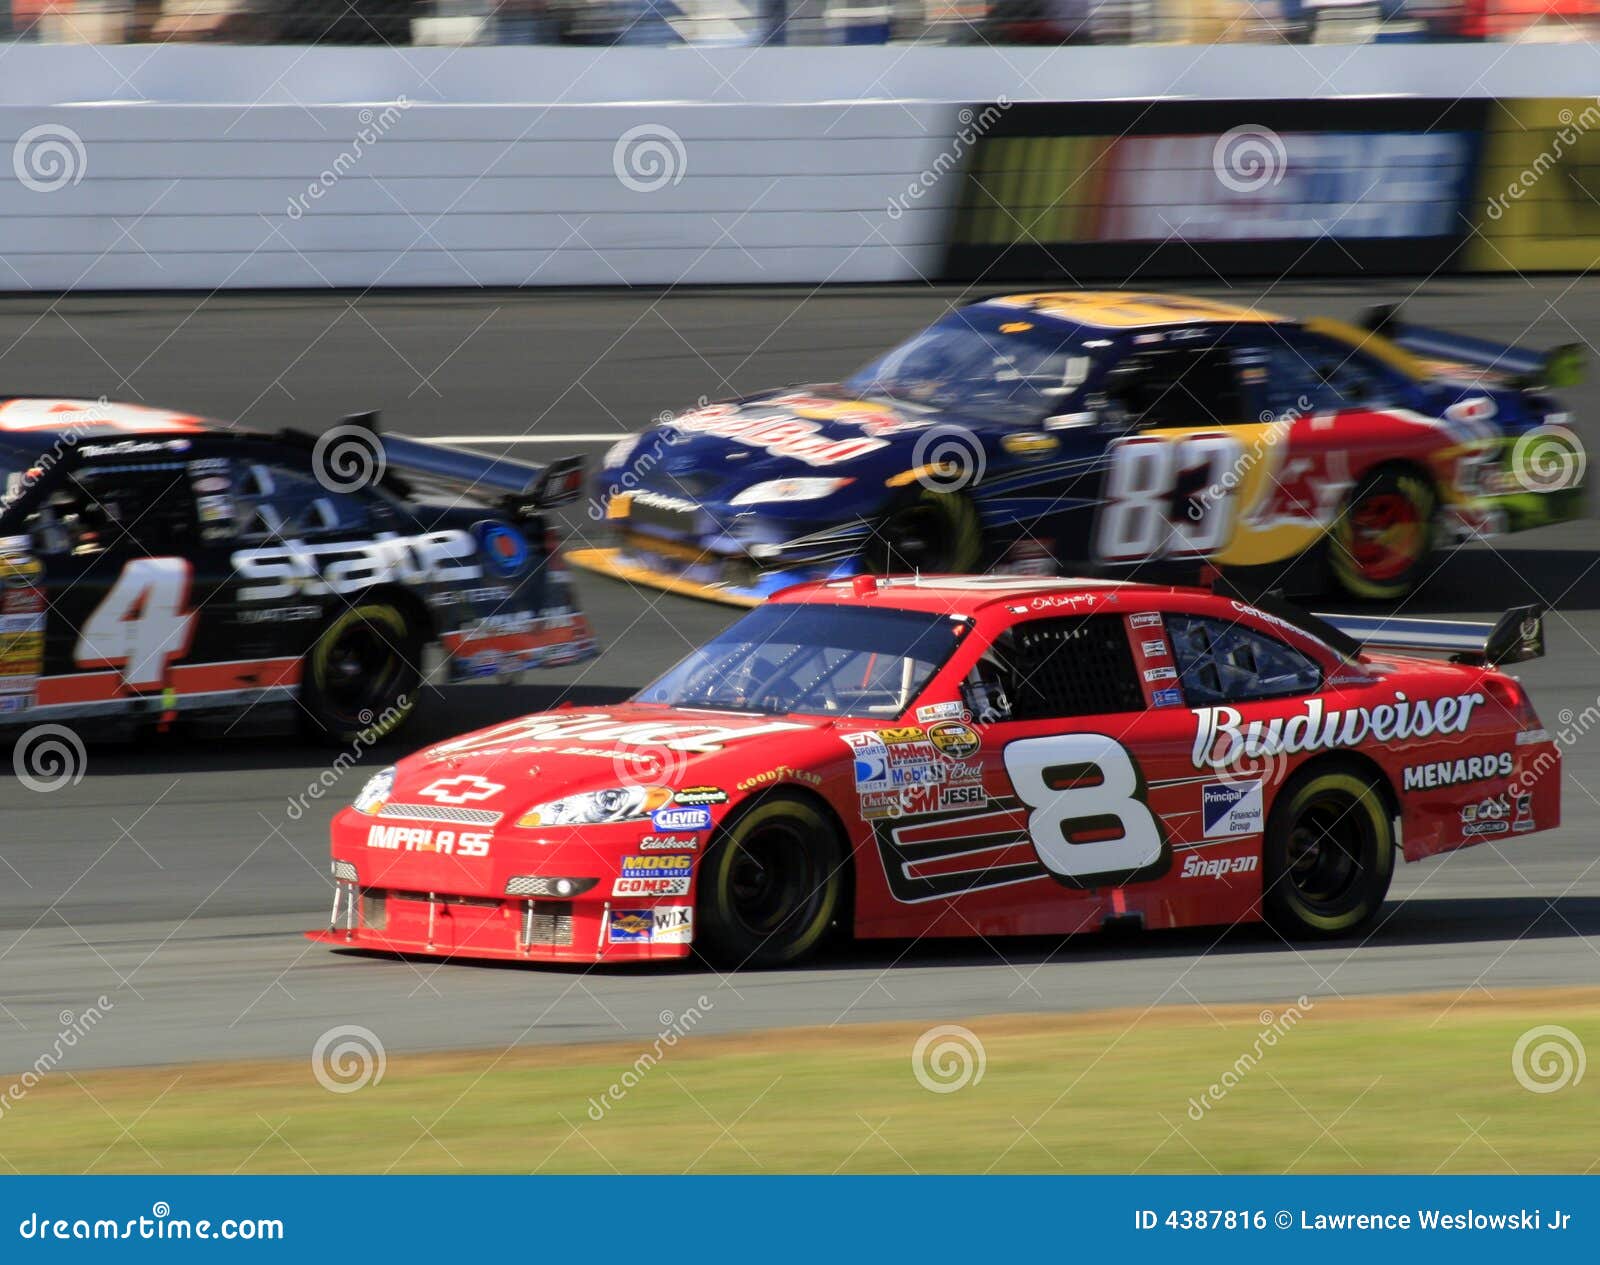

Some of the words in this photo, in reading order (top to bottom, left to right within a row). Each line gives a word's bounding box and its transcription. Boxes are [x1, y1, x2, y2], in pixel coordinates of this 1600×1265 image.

[1096, 432, 1242, 563] 83
[75, 557, 199, 691] 4
[425, 713, 815, 758] Bud
[1191, 691, 1484, 769] Budweiser
[855, 745, 888, 757] SPORTS
[737, 764, 823, 792] GOODYEAR
[891, 767, 928, 782] Mobil
[950, 761, 984, 779] Bud
[1404, 752, 1514, 791] MENARDS
[941, 786, 984, 805] JESEL
[1204, 789, 1242, 803] Principal
[656, 810, 706, 825] CLEVITE
[1003, 733, 1172, 888] 8
[1230, 808, 1261, 820] Financial
[1230, 821, 1251, 832] Group
[367, 825, 455, 855] IMPALA
[456, 832, 495, 857] SS
[640, 836, 697, 850] Edelbrock
[1181, 855, 1258, 880] Snap-on
[617, 880, 671, 892] COMP
[656, 909, 689, 930] WIX
